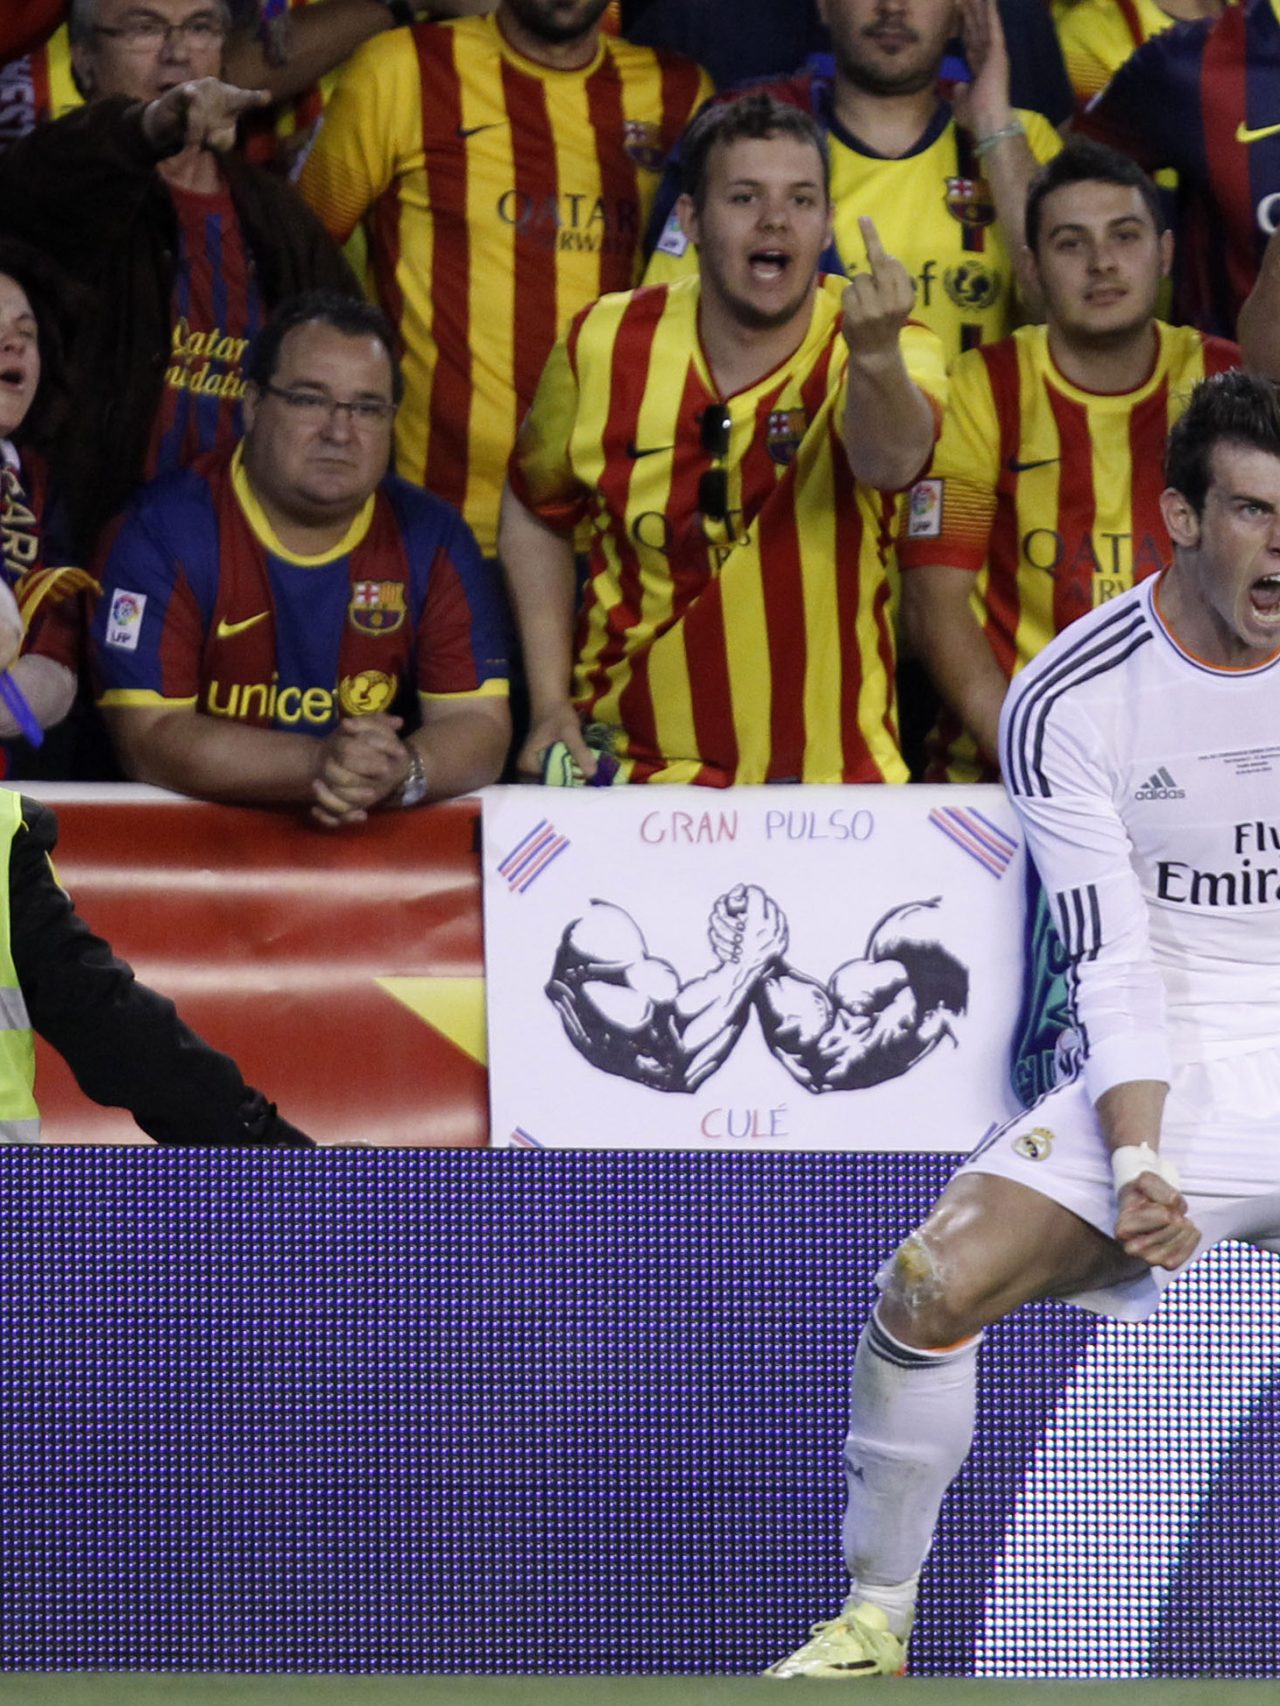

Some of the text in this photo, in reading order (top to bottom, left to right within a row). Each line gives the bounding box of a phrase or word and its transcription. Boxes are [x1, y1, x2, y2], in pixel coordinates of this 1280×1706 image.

[1022, 528, 1166, 580] QATA
[207, 669, 340, 724] unice
[1134, 787, 1186, 801] adidas
[639, 808, 875, 844] GRAN PULSO
[700, 1102, 790, 1138] CULÉ
